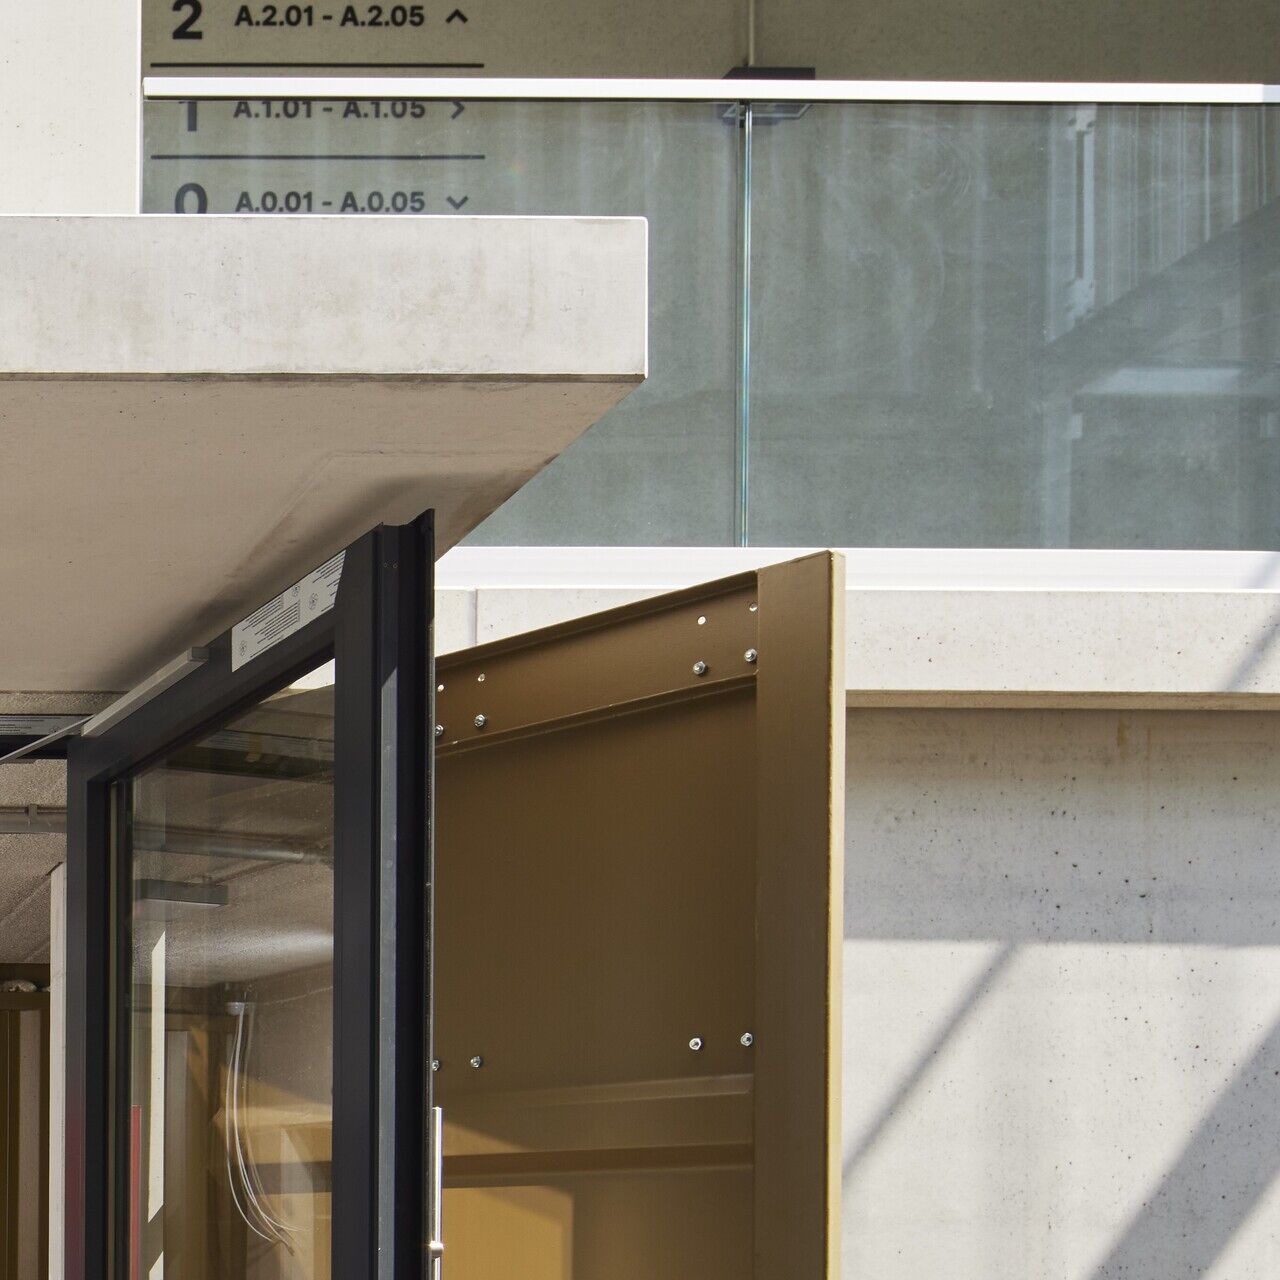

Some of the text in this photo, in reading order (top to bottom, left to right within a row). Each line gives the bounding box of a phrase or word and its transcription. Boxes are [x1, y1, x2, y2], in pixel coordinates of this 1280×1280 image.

[172, 0, 203, 39] 2
[234, 5, 313, 26] A.2.01
[340, 5, 425, 26] A.2.05
[233, 101, 312, 118] A.1.01
[342, 101, 425, 118] A.1.05
[235, 191, 312, 212] A.0.01
[340, 191, 425, 212] A.0.05
